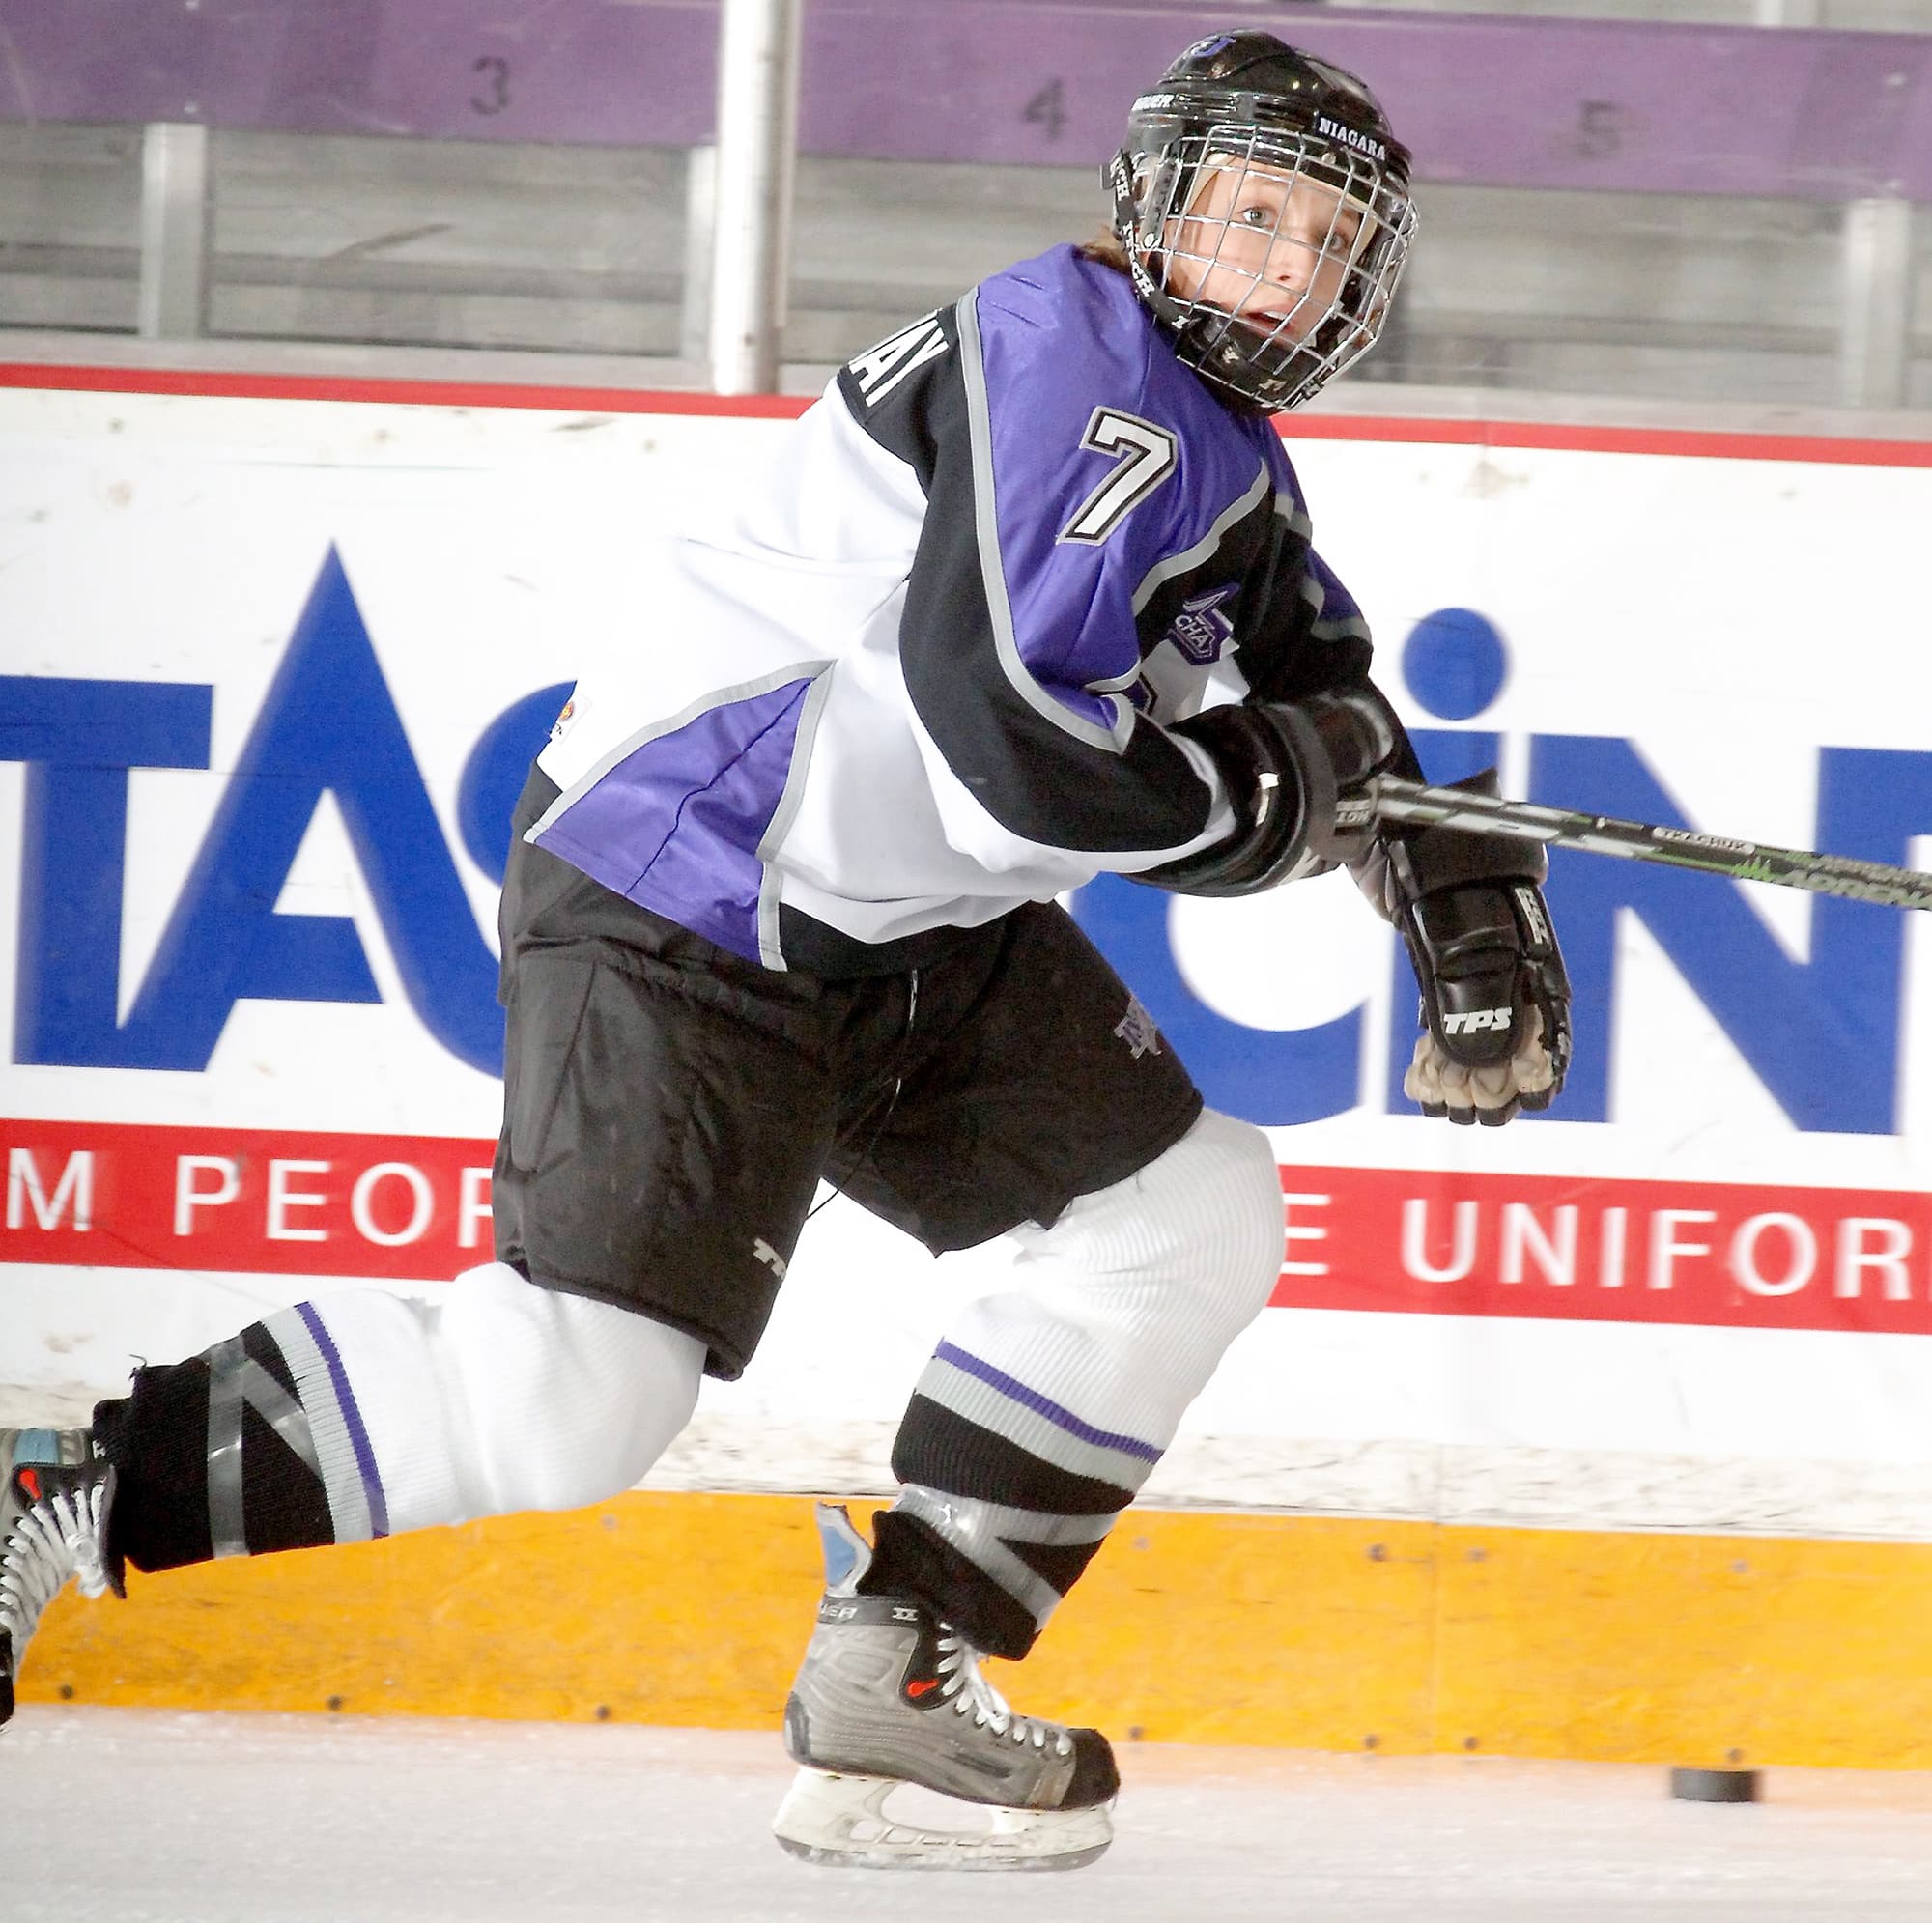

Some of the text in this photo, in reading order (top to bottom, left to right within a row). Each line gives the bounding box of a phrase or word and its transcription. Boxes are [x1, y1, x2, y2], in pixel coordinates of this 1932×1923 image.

[470, 56, 510, 116] 3
[1022, 75, 1066, 141] 4
[1318, 116, 1386, 161] NIAGARA
[1577, 99, 1623, 161] 5
[848, 307, 950, 408] AY
[1055, 405, 1179, 546] 7
[1443, 1006, 1513, 1035] TPS
